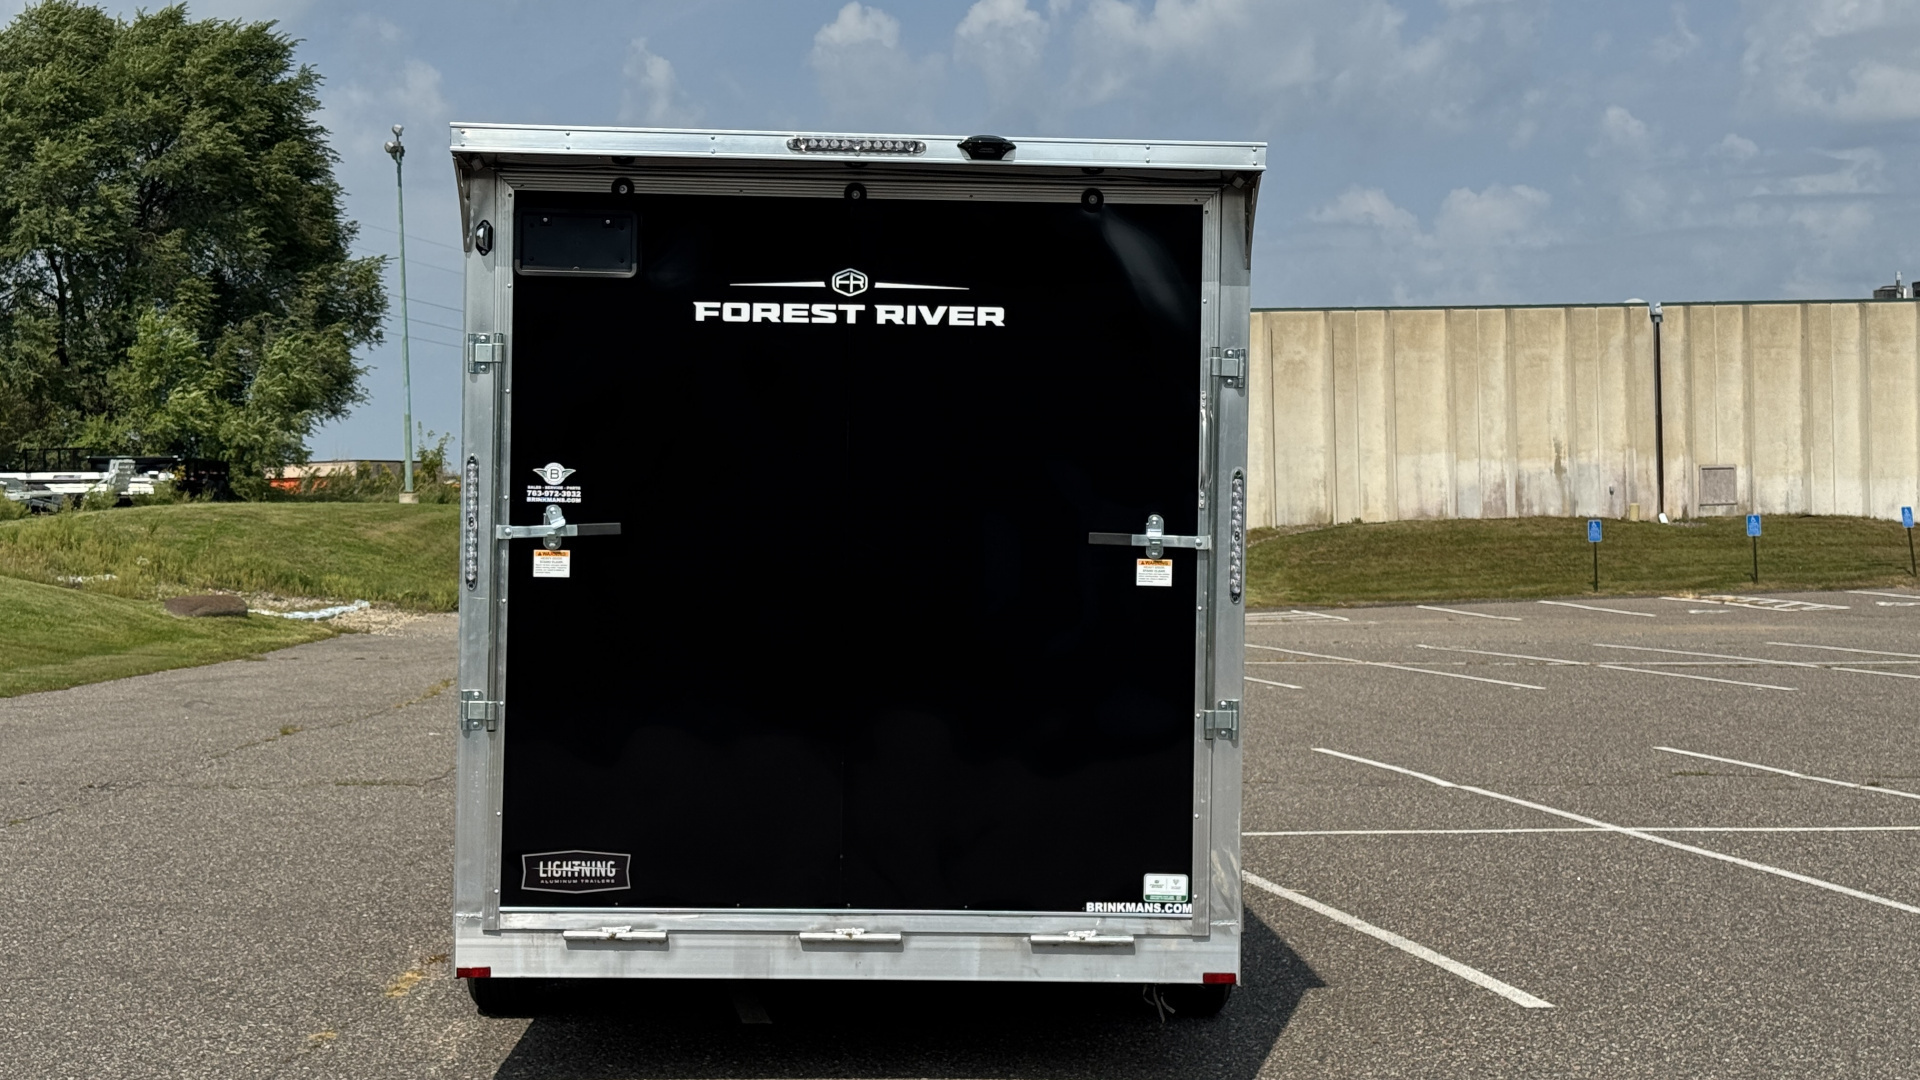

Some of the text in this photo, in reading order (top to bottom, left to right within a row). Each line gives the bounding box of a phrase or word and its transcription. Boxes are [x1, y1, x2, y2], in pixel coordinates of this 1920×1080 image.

[693, 301, 1005, 327] FOREST RIVER
[539, 860, 616, 878] LIGHTNING
[1086, 902, 1193, 914] BRINKMANS.COM
